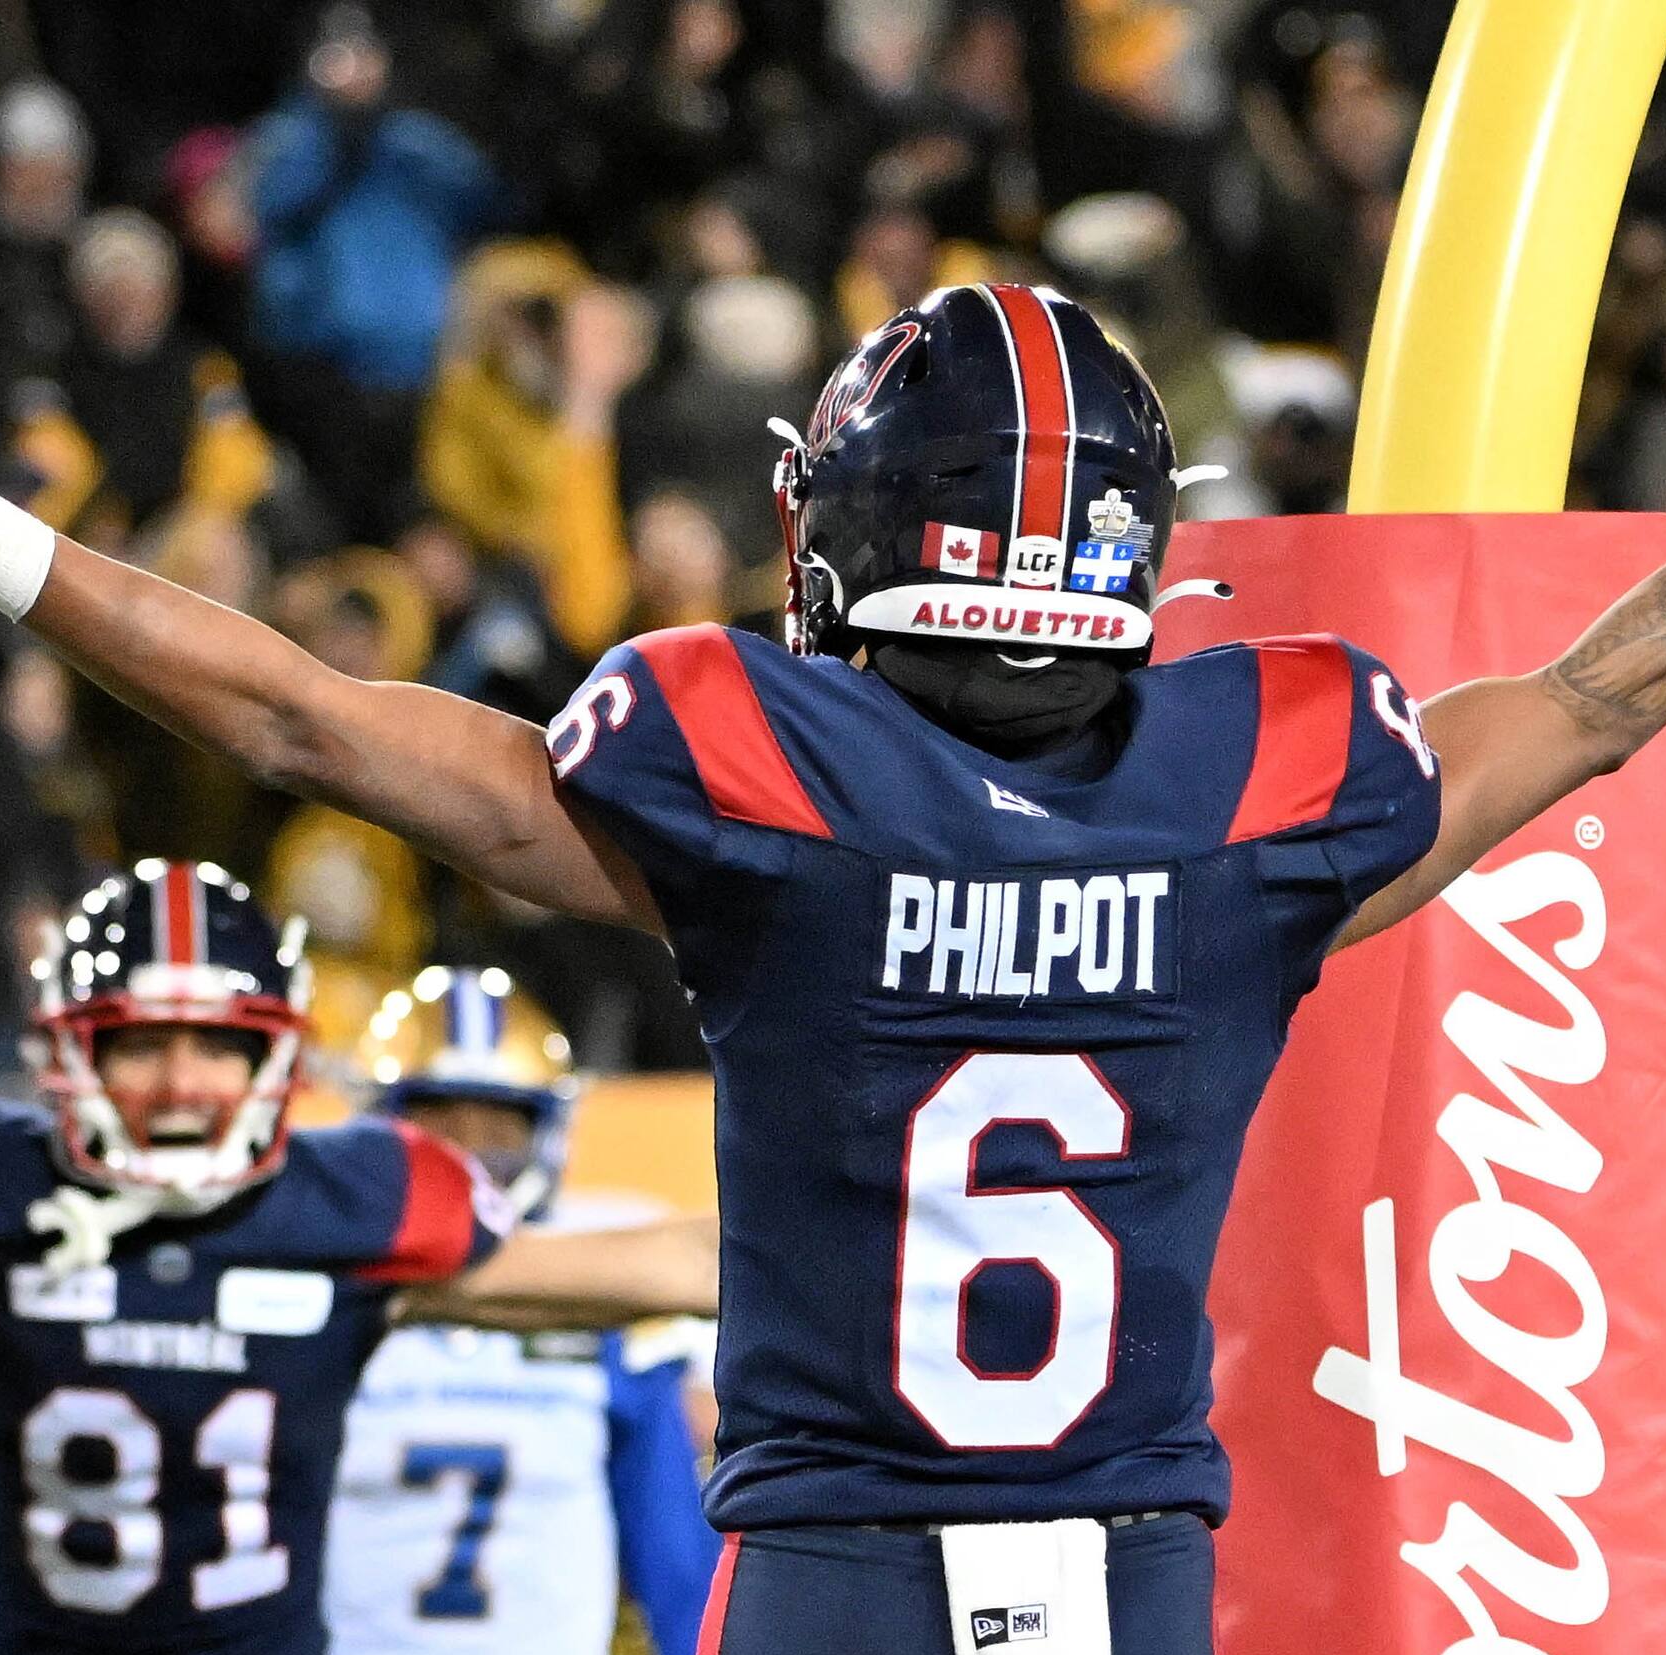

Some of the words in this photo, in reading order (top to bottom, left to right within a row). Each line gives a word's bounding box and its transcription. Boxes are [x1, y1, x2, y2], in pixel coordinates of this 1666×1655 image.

[910, 601, 1126, 640] ALOUETTES
[1016, 551, 1058, 572] LCF
[545, 671, 638, 781] 6
[882, 870, 1169, 998] PHILPOT
[892, 1050, 1132, 1451] 6
[21, 1386, 291, 1615] 81
[400, 1443, 511, 1622] 7
[1013, 1612, 1041, 1623] NEW
